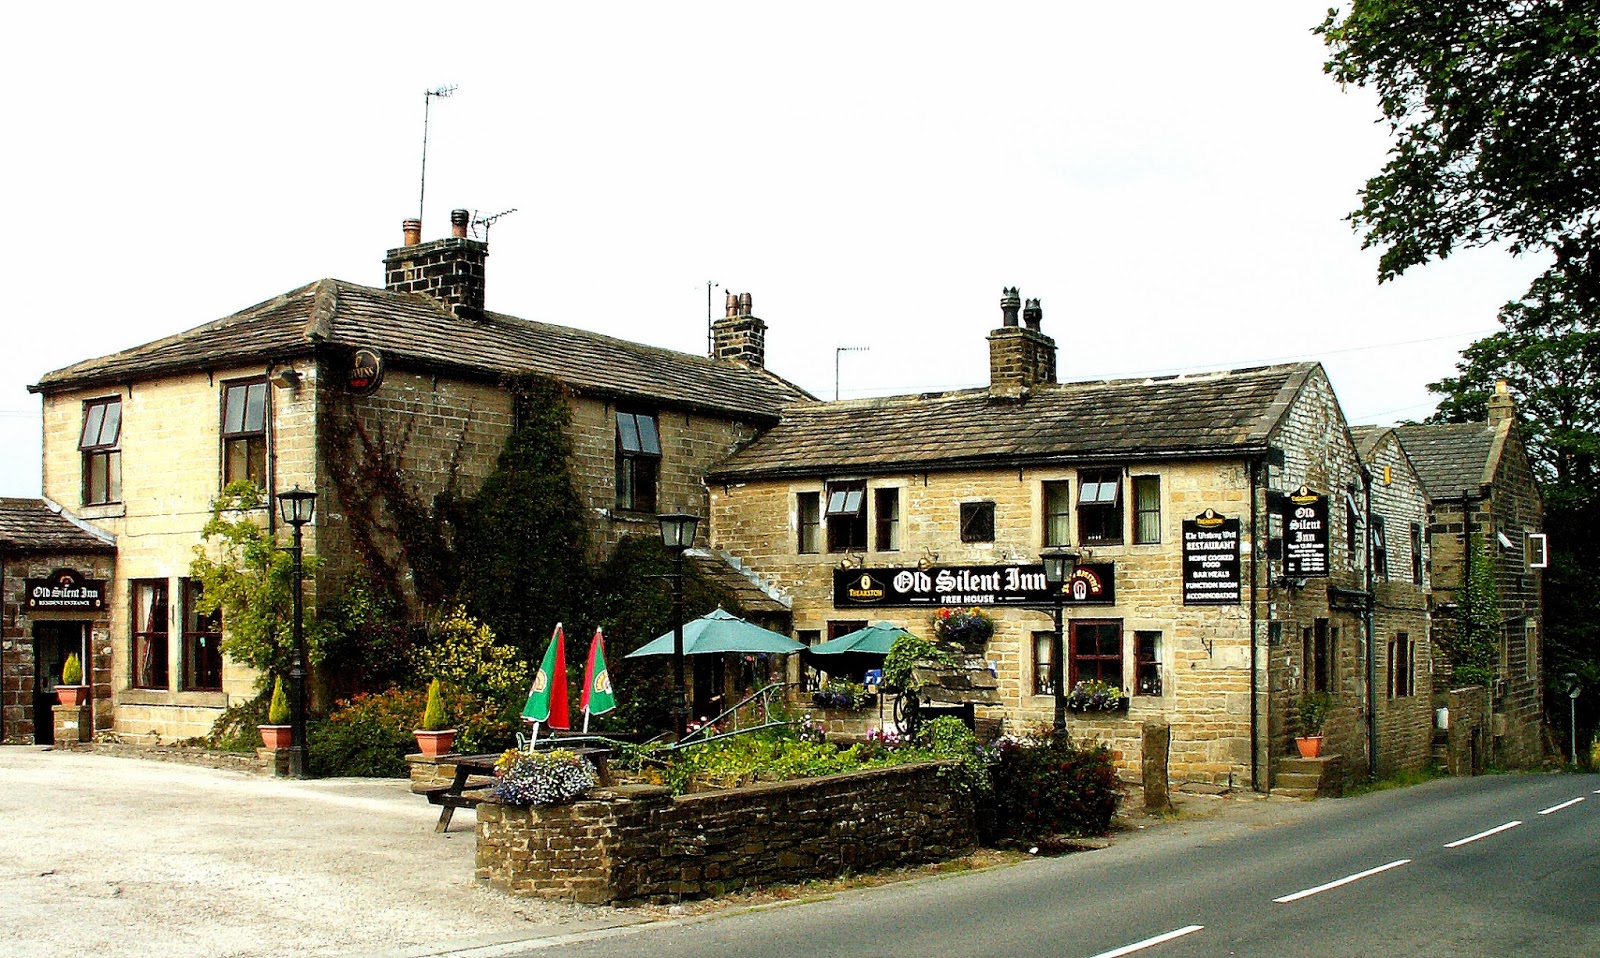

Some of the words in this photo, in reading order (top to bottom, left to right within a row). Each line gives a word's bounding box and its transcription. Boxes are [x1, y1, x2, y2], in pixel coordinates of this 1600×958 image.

[1295, 507, 1315, 518] Old
[1289, 519, 1321, 530] Silent
[1295, 531, 1316, 542] Inn
[1186, 541, 1235, 550] RESTAURANT
[893, 570, 931, 593] Old
[935, 569, 1001, 593] Silent
[1004, 567, 1047, 591] Inn
[33, 586, 51, 598] Old
[52, 586, 79, 598] Silent
[80, 586, 98, 598] Inn
[941, 595, 961, 604] FREE
[964, 594, 995, 603] HOUSE
